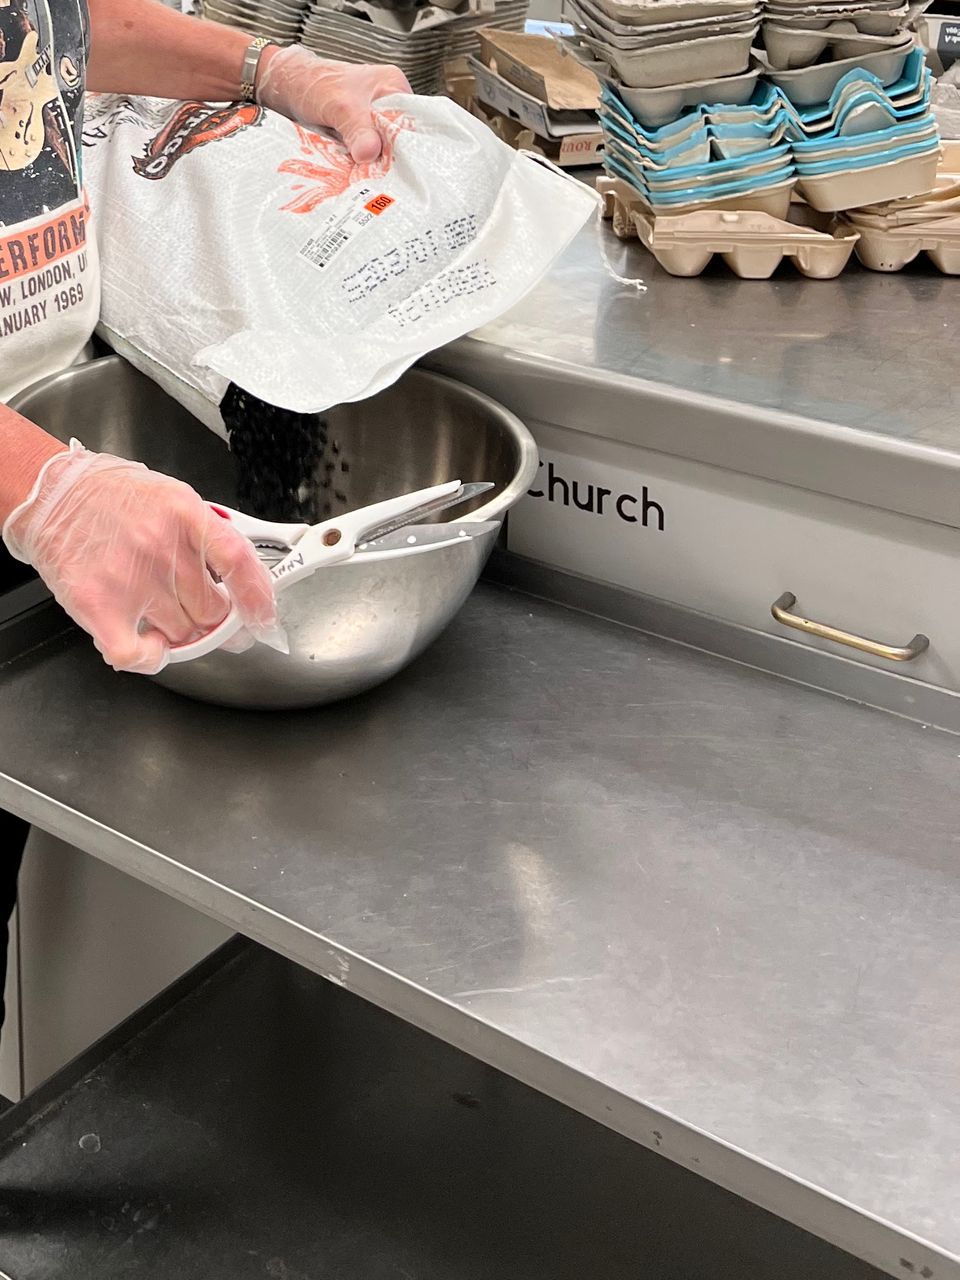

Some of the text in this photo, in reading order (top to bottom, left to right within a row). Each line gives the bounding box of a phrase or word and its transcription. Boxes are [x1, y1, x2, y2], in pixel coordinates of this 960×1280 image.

[371, 195, 392, 211] 160
[21, 260, 76, 300] LONDON,
[54, 282, 84, 313] 1969
